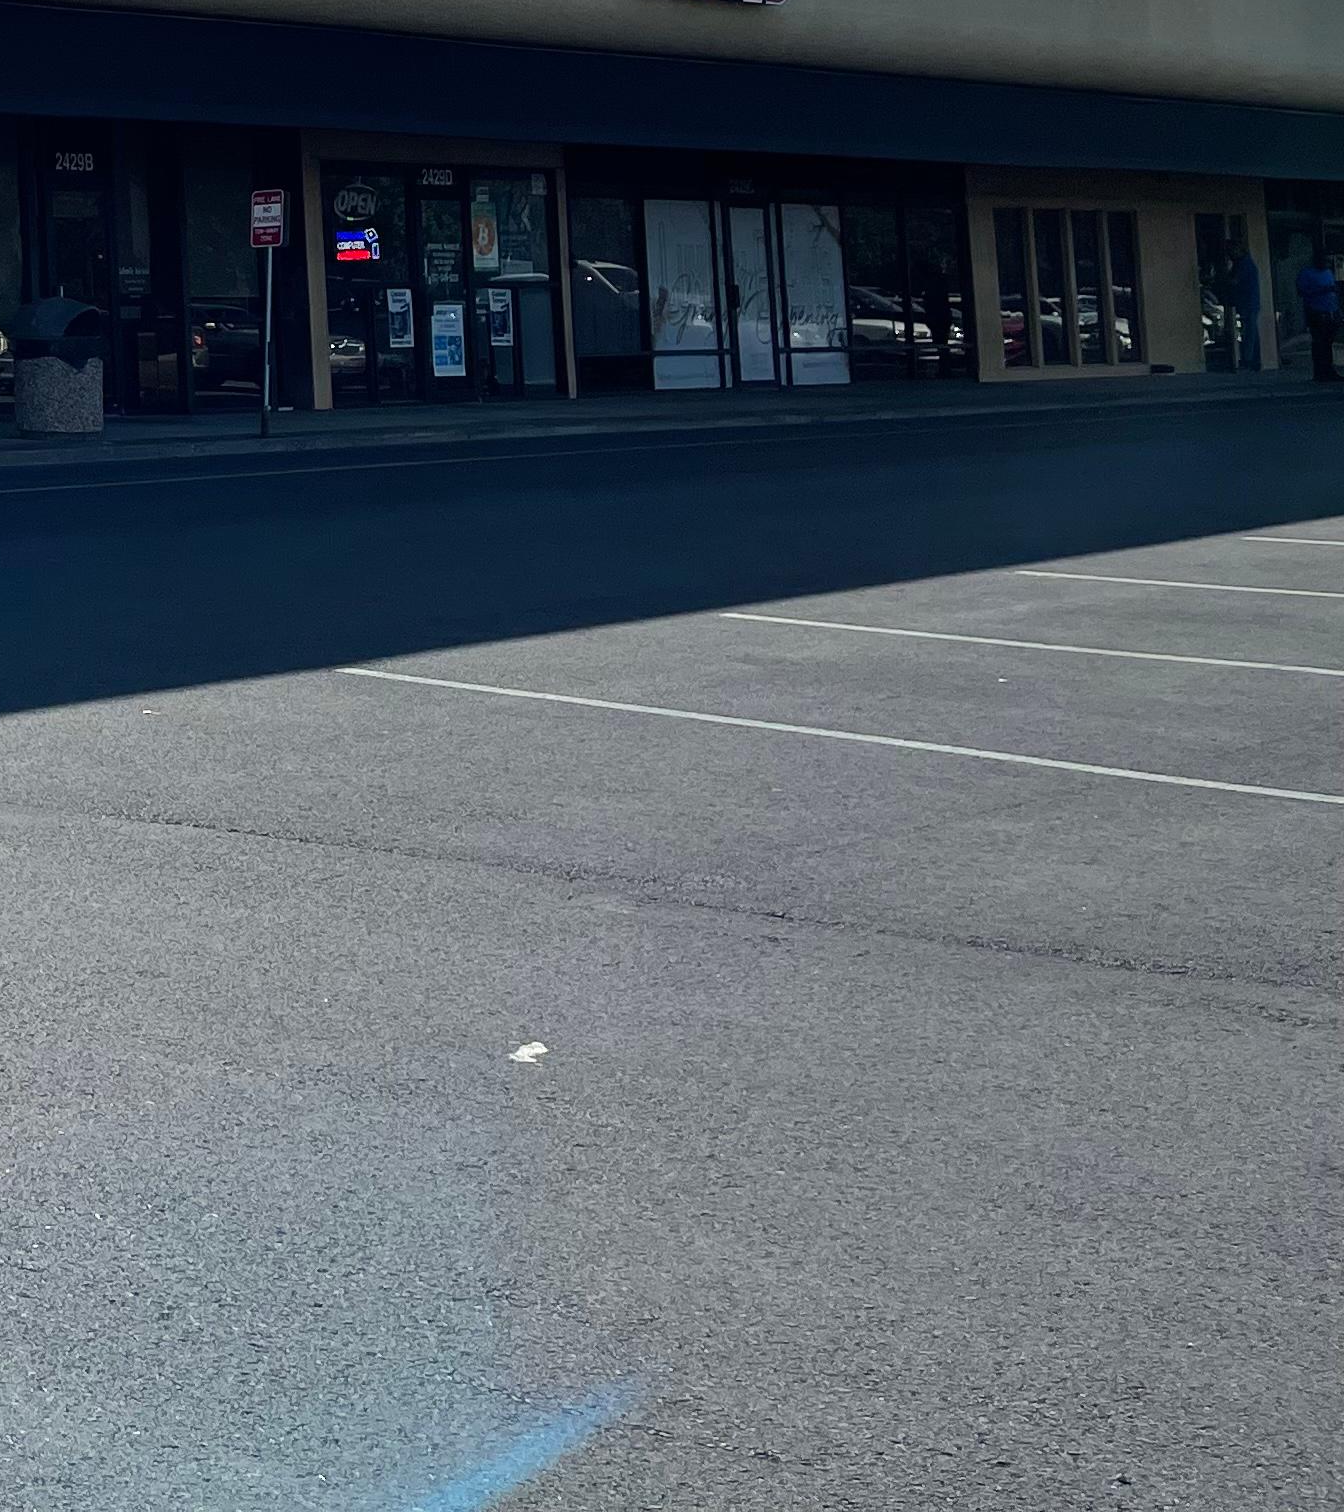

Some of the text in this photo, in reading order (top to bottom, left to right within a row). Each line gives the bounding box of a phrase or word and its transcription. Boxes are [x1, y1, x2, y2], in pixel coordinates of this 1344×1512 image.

[55, 151, 94, 172] 2429B
[421, 168, 454, 186] 2429D
[337, 190, 377, 216] OPEN
[254, 216, 280, 224] PARKING
